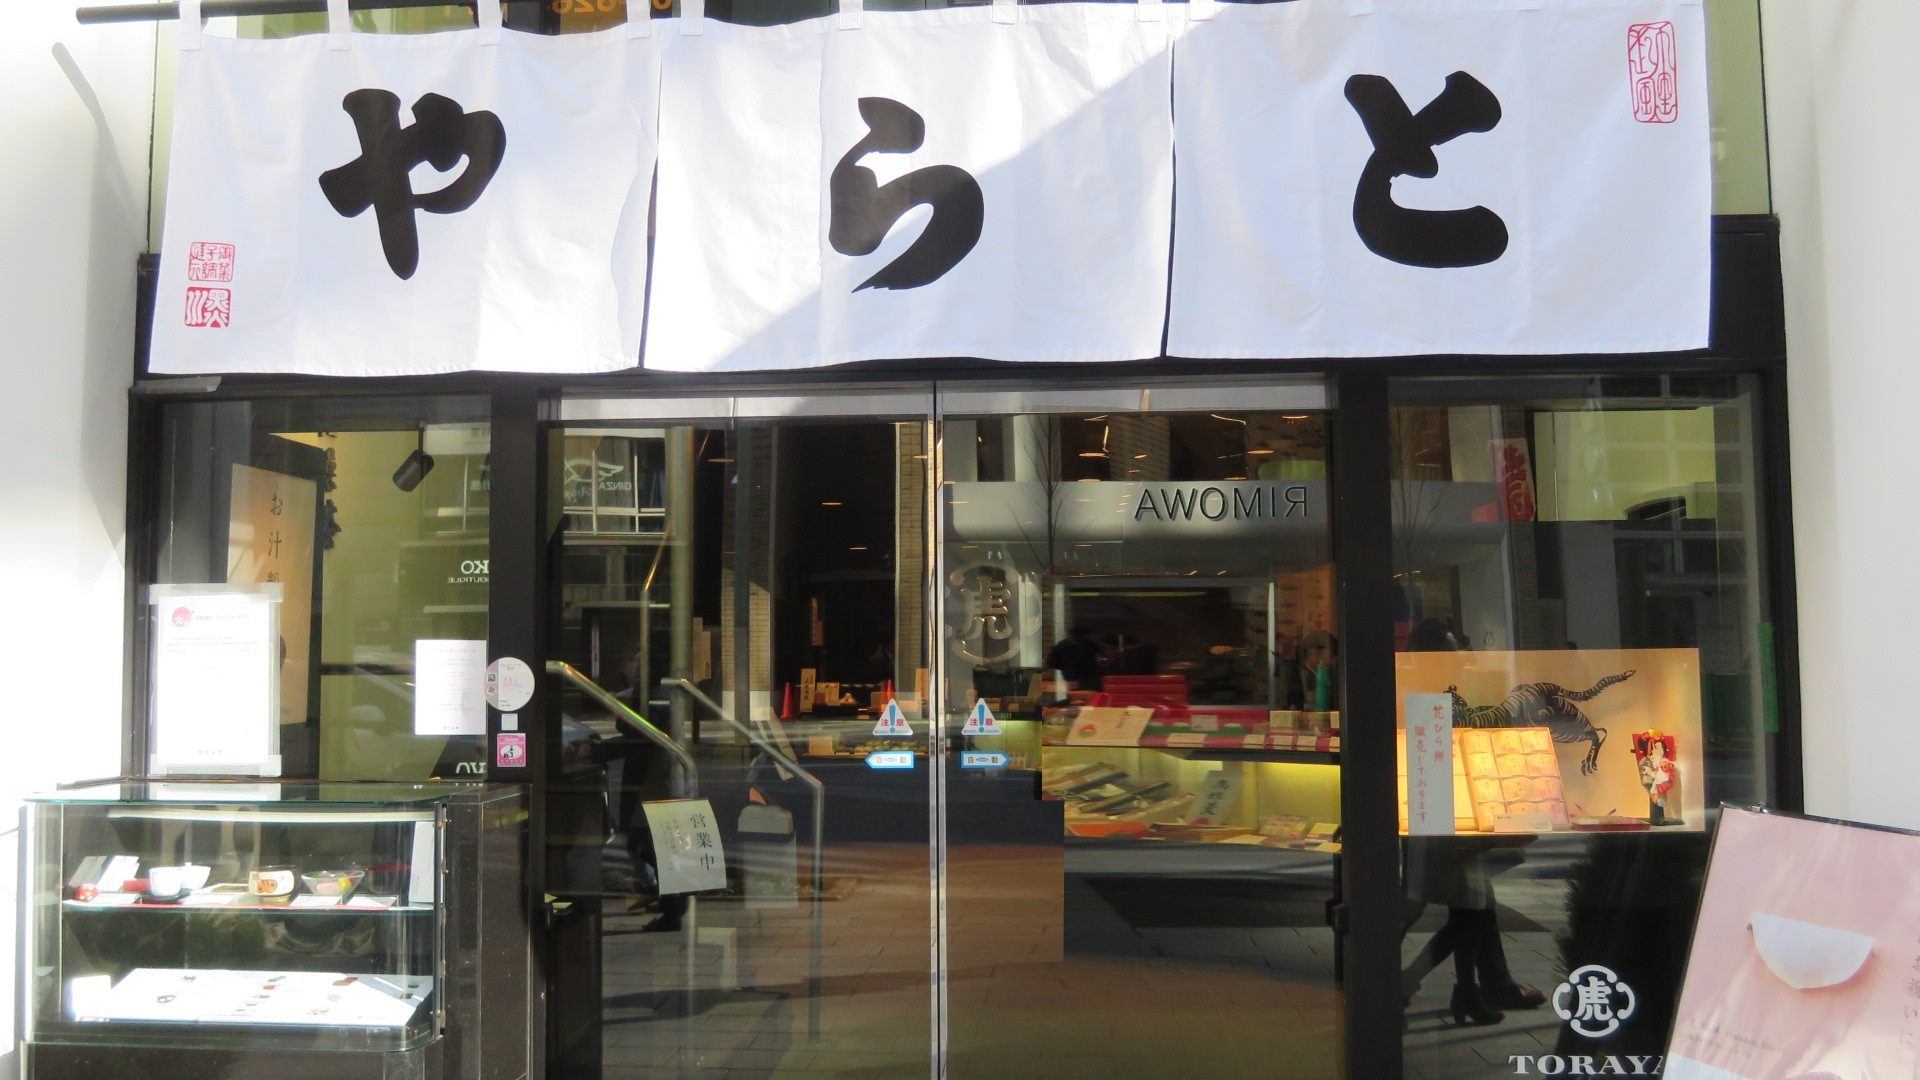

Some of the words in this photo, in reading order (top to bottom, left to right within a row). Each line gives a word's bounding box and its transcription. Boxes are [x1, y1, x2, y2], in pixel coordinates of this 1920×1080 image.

[319, 88, 506, 280] や
[829, 96, 985, 293] ら
[1344, 70, 1509, 269] と
[690, 812, 714, 871] 営業中
[1574, 976, 1613, 1021] 虎
